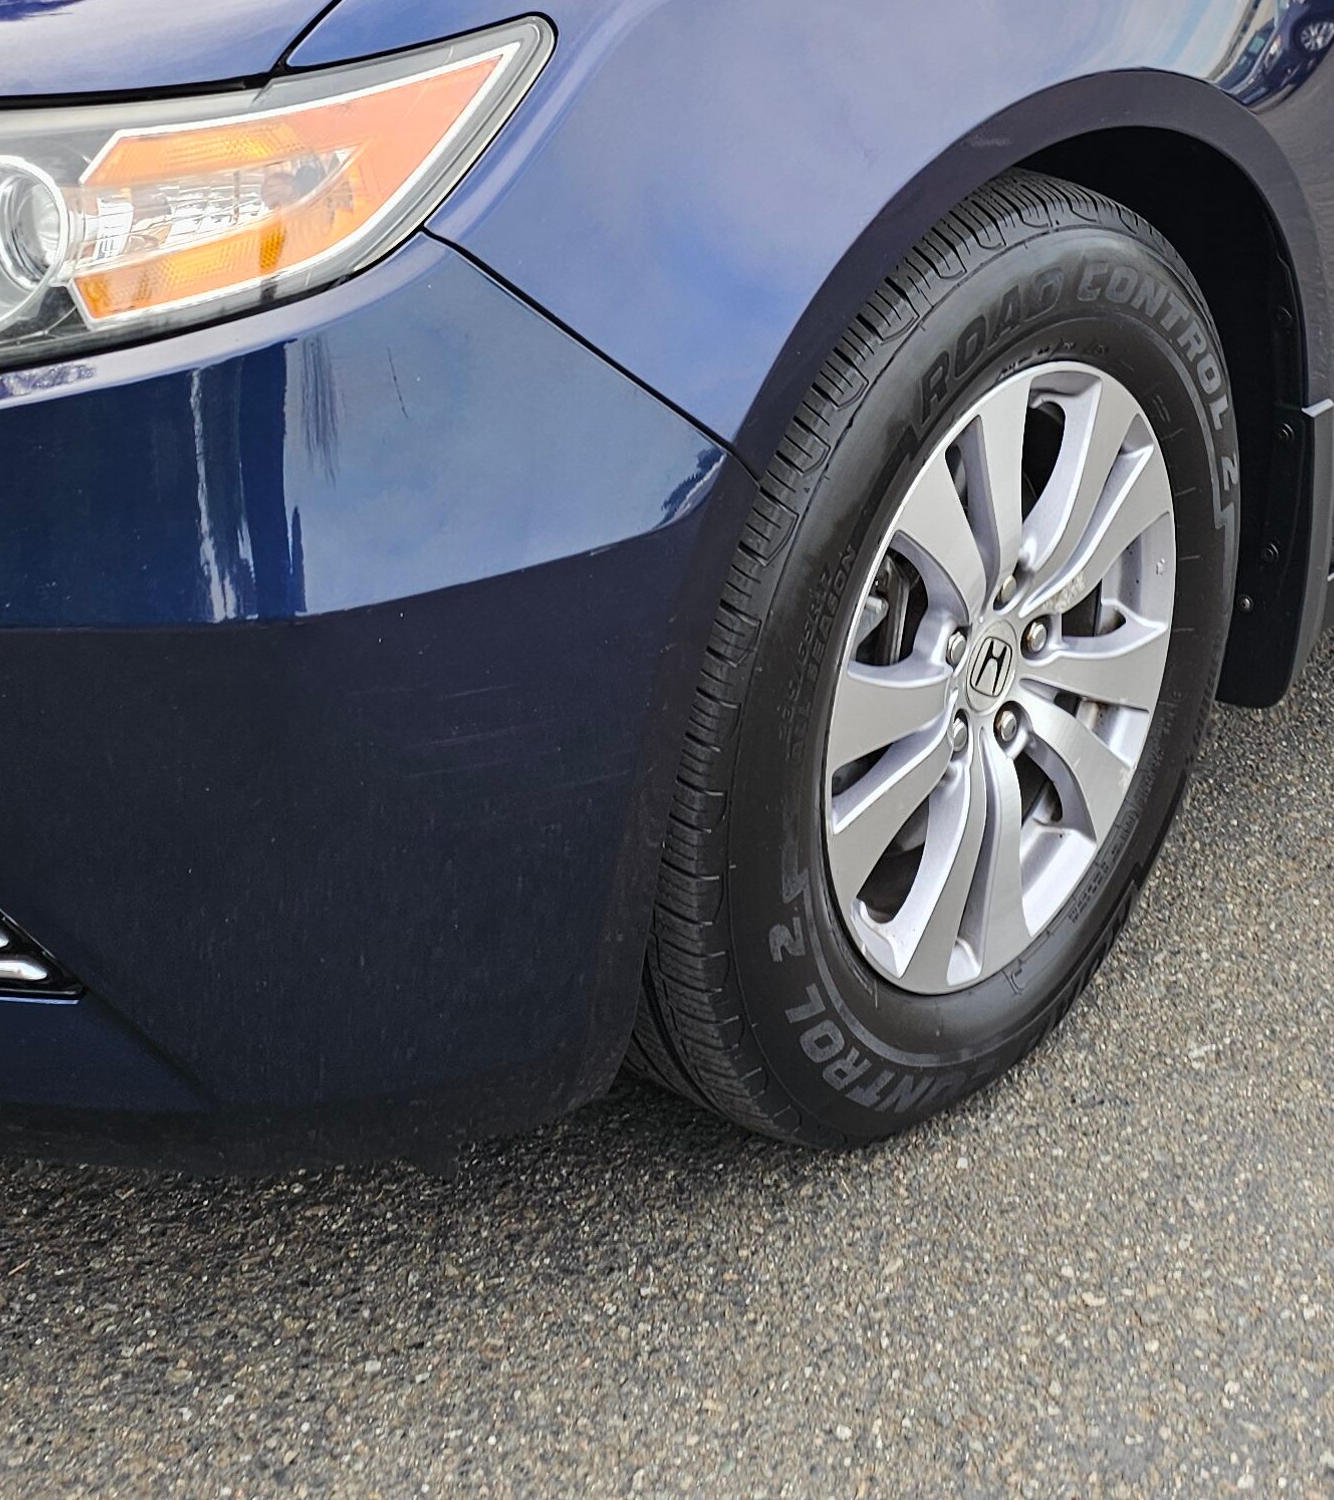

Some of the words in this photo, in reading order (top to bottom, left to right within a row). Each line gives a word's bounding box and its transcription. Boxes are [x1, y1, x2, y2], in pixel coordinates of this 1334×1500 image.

[921, 267, 1065, 425] ROAD
[1076, 262, 1231, 431] CONTROL
[1220, 452, 1239, 491] 2
[768, 916, 807, 963] 2
